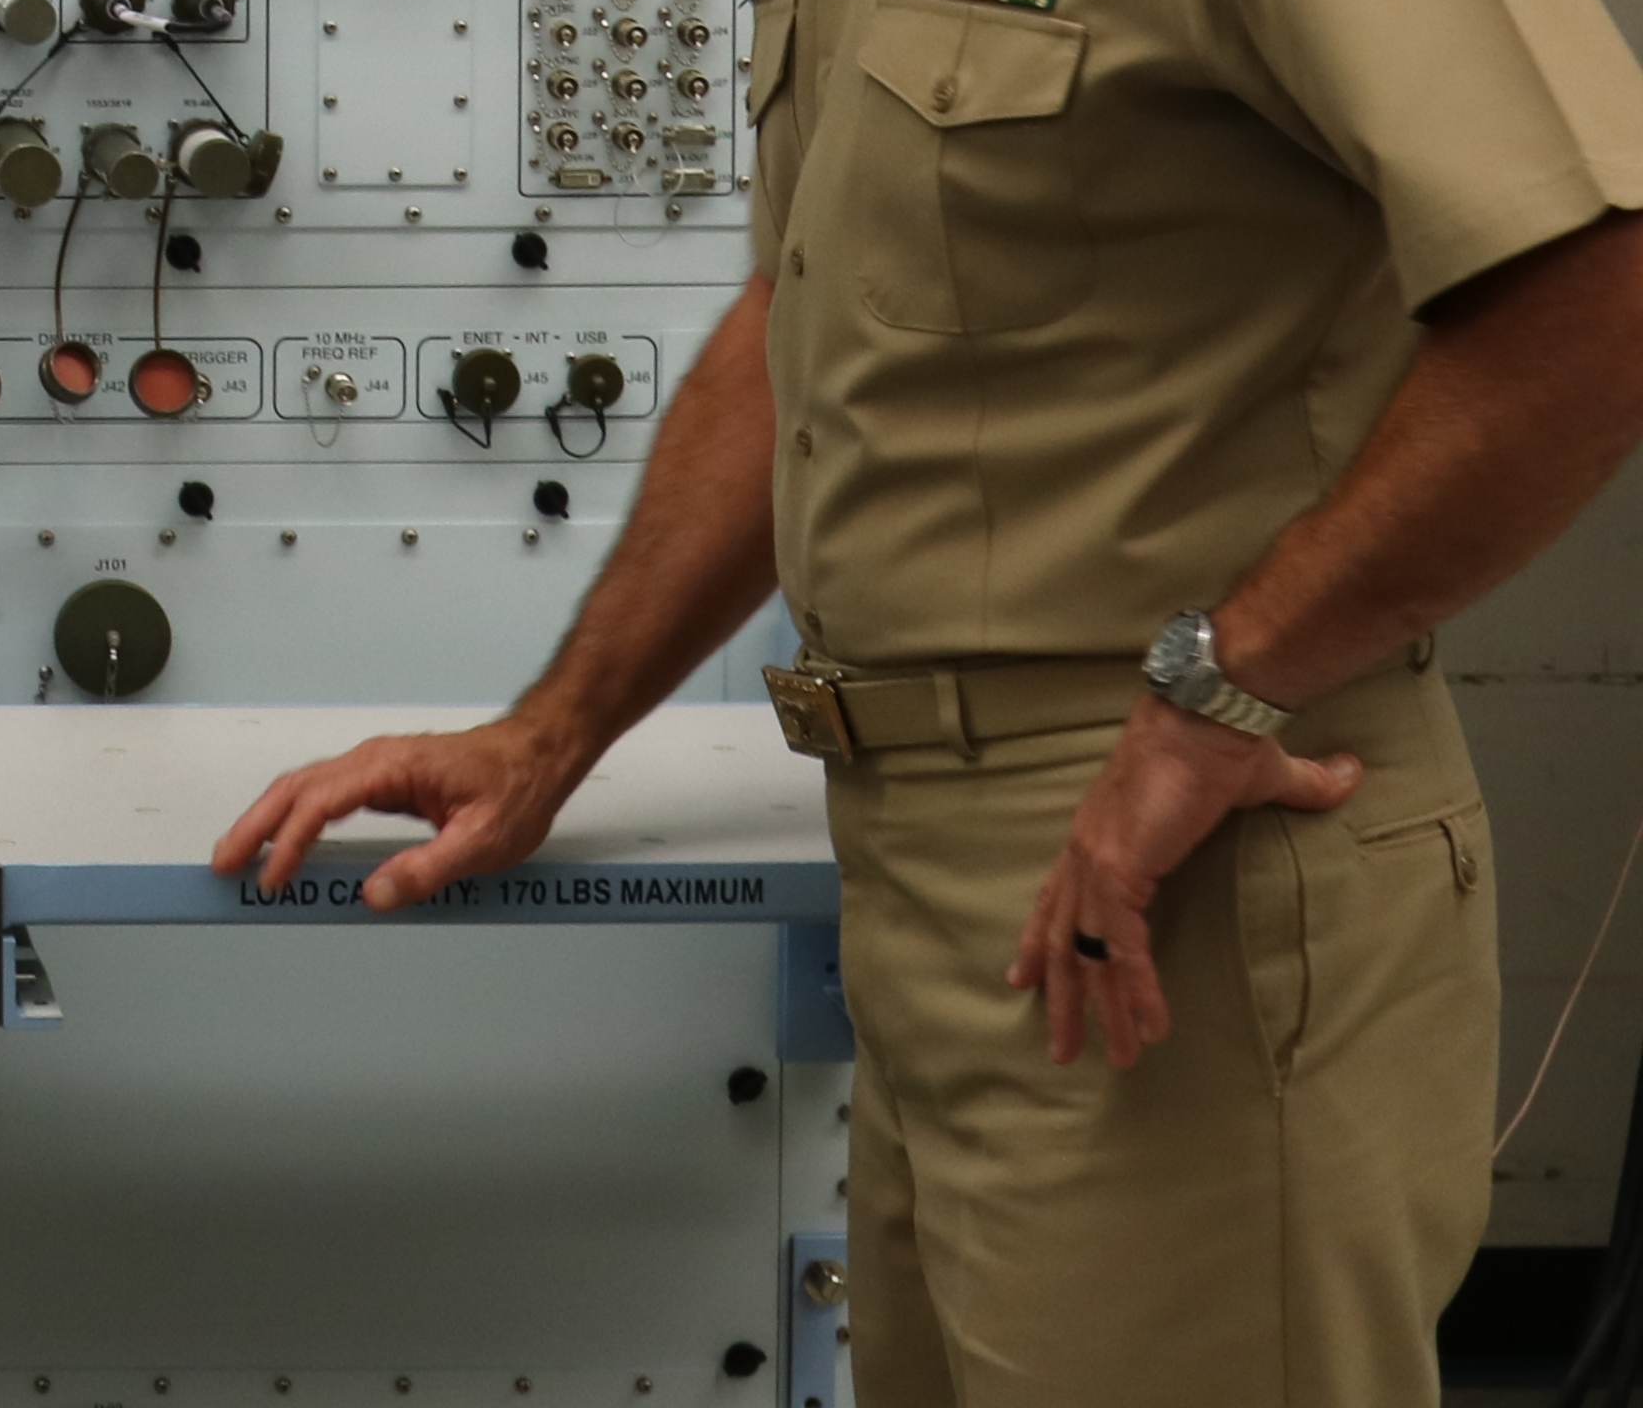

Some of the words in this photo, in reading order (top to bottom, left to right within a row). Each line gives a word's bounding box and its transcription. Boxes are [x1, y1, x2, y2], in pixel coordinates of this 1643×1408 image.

[315, 333, 331, 345] 10
[335, 333, 365, 345] MHz
[464, 333, 503, 344] ENET
[526, 333, 548, 344] INT
[577, 332, 607, 344] USB
[302, 348, 344, 360] FREQ
[348, 347, 377, 359] REF
[524, 372, 549, 385] J45
[626, 372, 651, 384] J46
[102, 381, 126, 393] J42
[223, 381, 246, 393] J43
[365, 380, 389, 392] J44
[94, 558, 128, 571] J101
[239, 877, 319, 907] LOAD
[497, 877, 547, 905] 170
[555, 877, 611, 905] LBS
[619, 876, 764, 905] MAXIMUM
